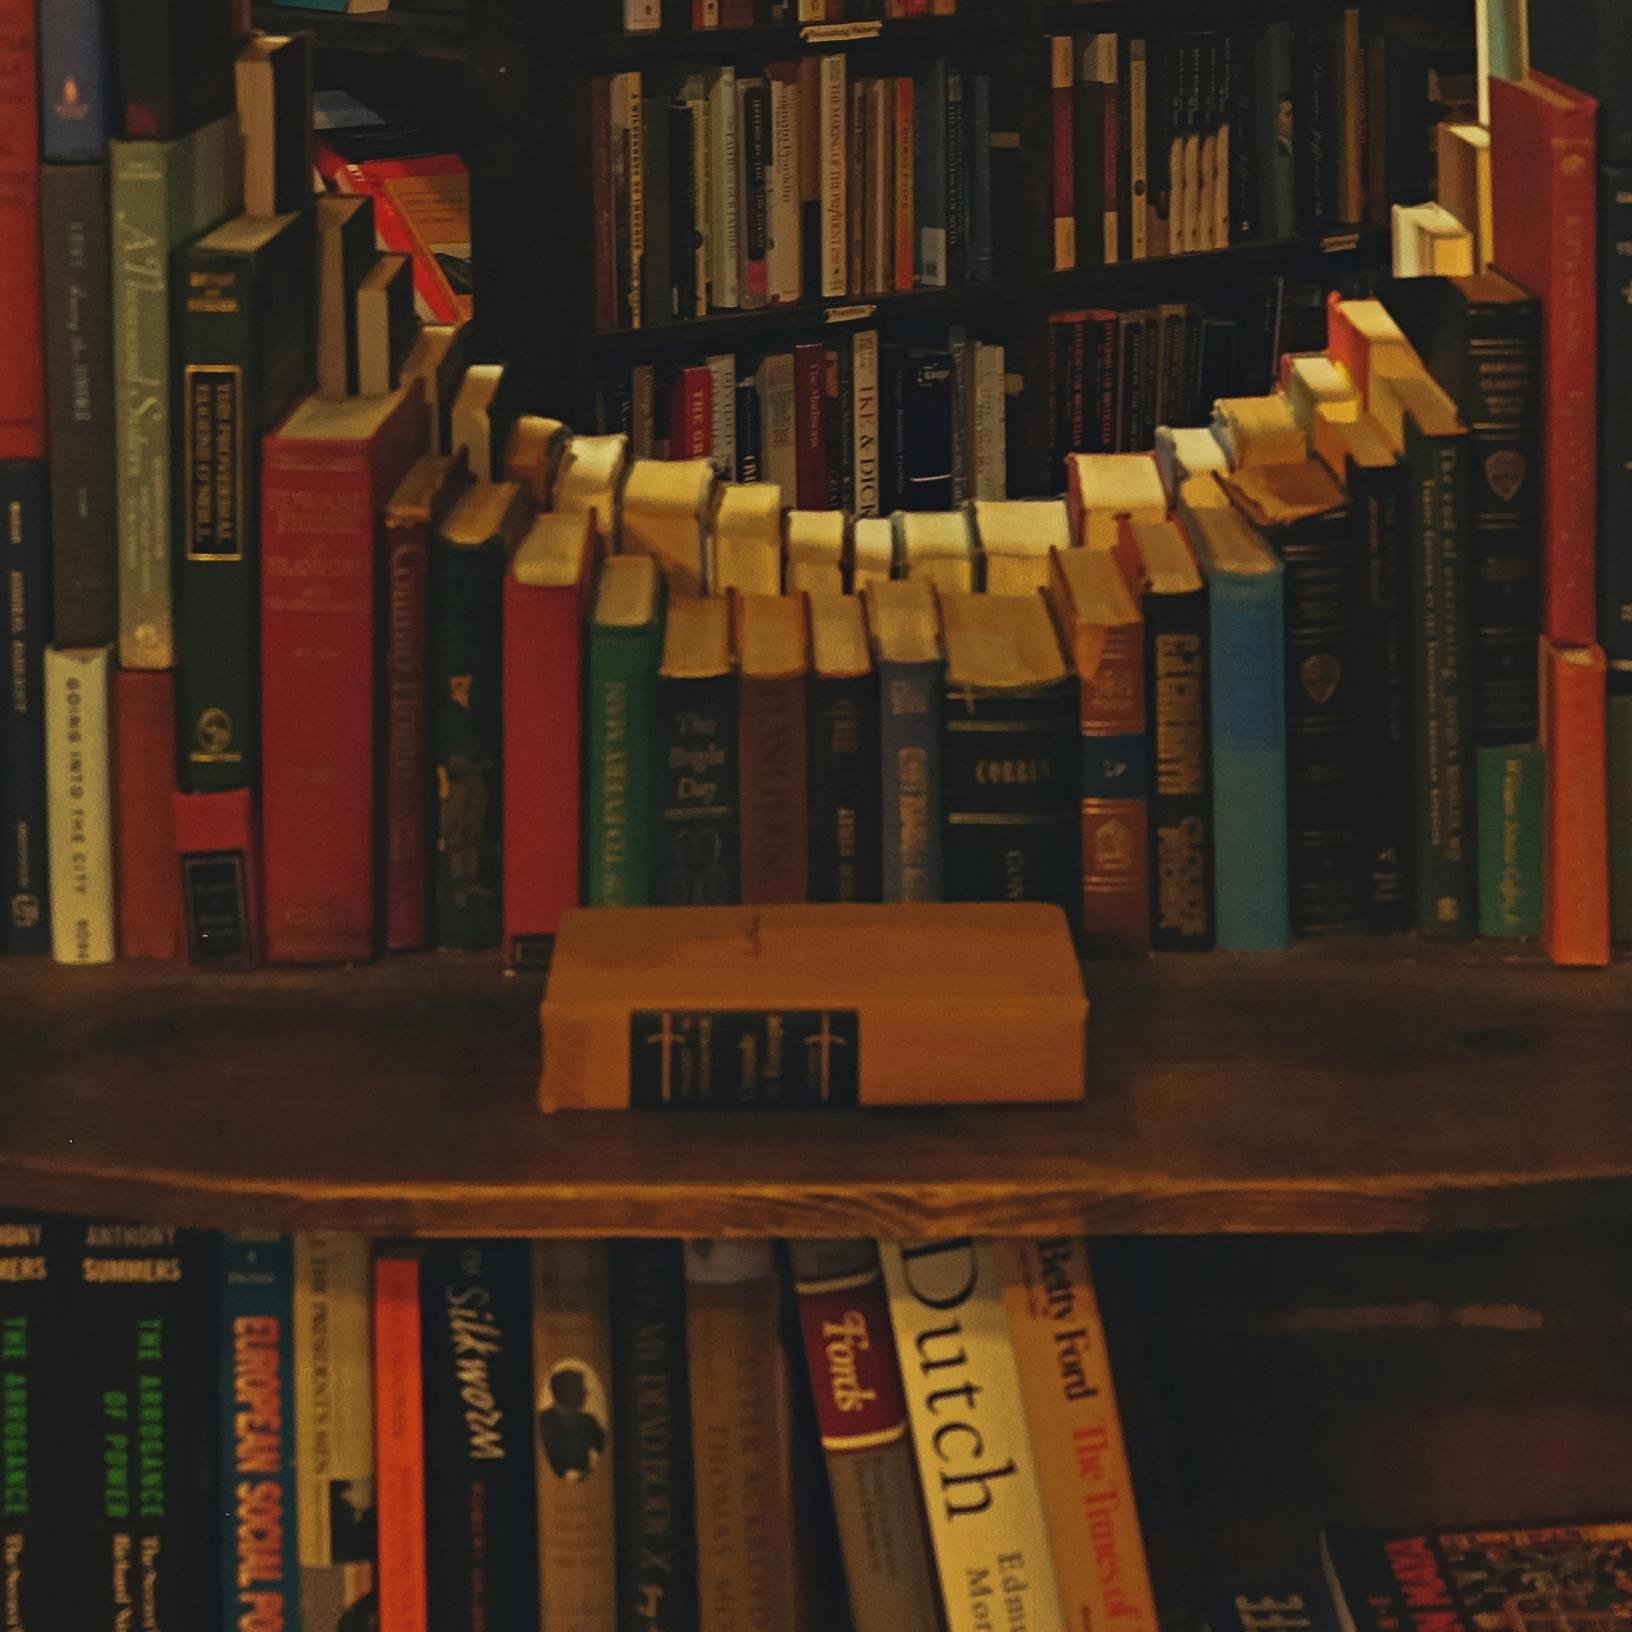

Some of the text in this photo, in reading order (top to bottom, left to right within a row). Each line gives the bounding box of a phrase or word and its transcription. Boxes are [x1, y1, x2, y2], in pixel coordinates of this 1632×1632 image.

[860, 386, 878, 424] IKE
[67, 677, 88, 893] GOING CITY
[233, 1316, 283, 1587] EUROPEAN SOCIAL
[446, 1284, 506, 1460] Silkworm
[822, 1309, 876, 1412] Fords
[902, 1238, 1016, 1521] Dutch
[1054, 1328, 1120, 1578] Ford The Times
